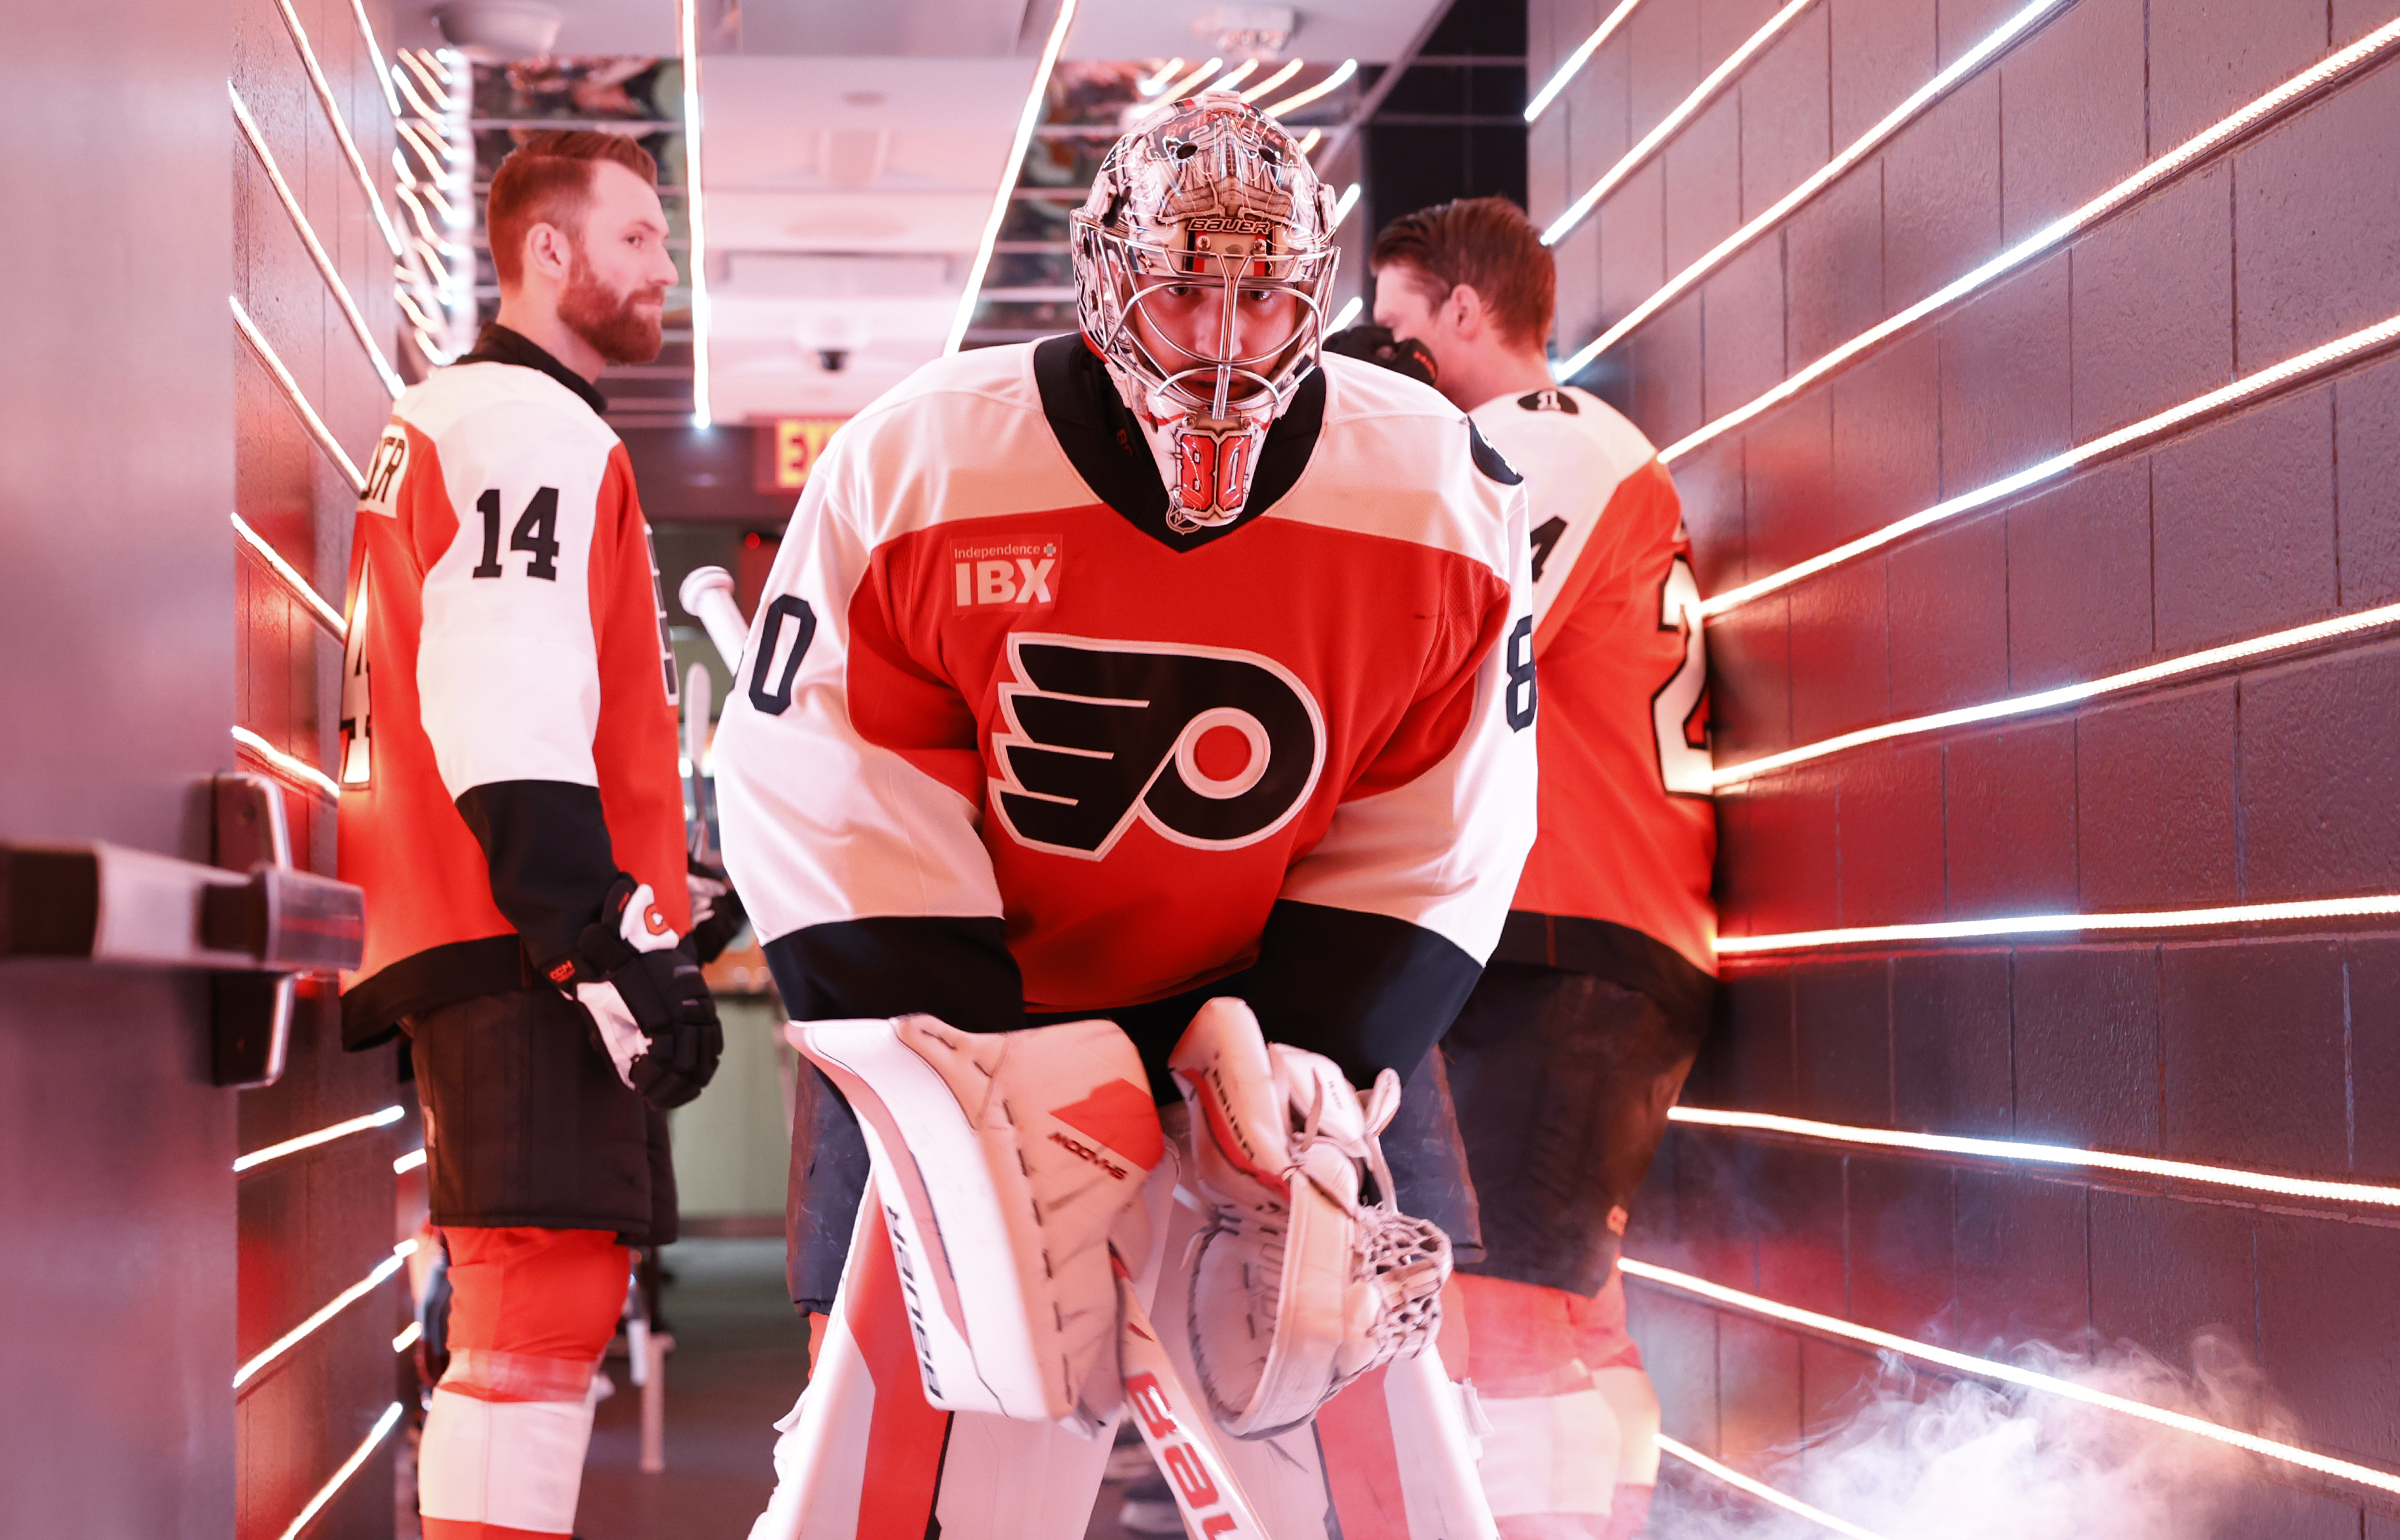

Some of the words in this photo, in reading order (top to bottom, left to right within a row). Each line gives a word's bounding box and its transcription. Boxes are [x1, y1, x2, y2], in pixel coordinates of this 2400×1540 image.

[1187, 218, 1271, 235] BAUER
[1181, 433, 1252, 513] 80
[473, 486, 560, 582] 14
[954, 543, 1040, 559] Independence
[955, 558, 1056, 607] IBX
[735, 593, 817, 716] 0
